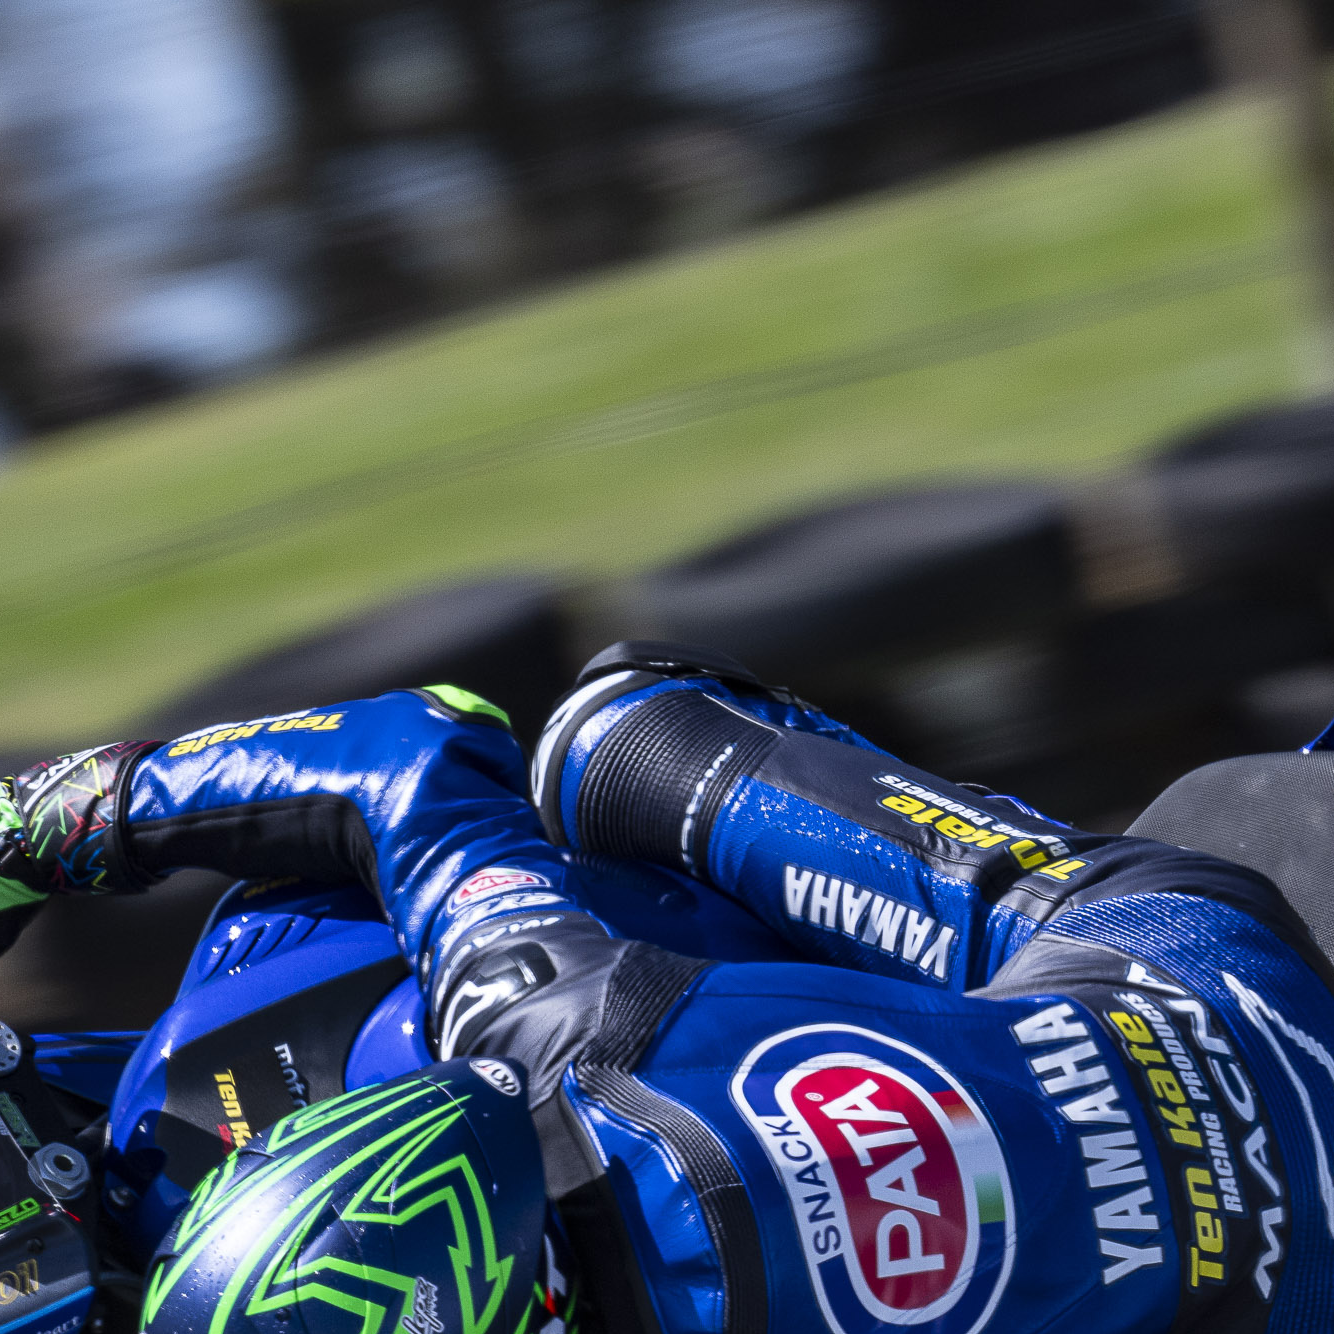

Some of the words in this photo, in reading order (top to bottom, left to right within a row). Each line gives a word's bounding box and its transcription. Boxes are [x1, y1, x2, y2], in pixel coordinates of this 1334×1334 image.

[168, 723, 265, 757] Kate
[268, 713, 344, 732] Ten
[879, 775, 993, 826] PRODUCTS
[882, 795, 1010, 848] Kate
[1010, 840, 1087, 880] Tn
[784, 864, 957, 981] YAMAHA
[214, 1068, 244, 1125] Ten
[1110, 1011, 1202, 1148] Kate
[1119, 992, 1210, 1101] PRODUCTS
[765, 1115, 842, 1254] SNACK
[818, 1078, 945, 1278] PATA
[1009, 1003, 1163, 1285] YAMAHA
[1127, 962, 1283, 1300] MACNA
[1201, 1112, 1244, 1213] RACING
[1186, 1166, 1224, 1287] Ten
